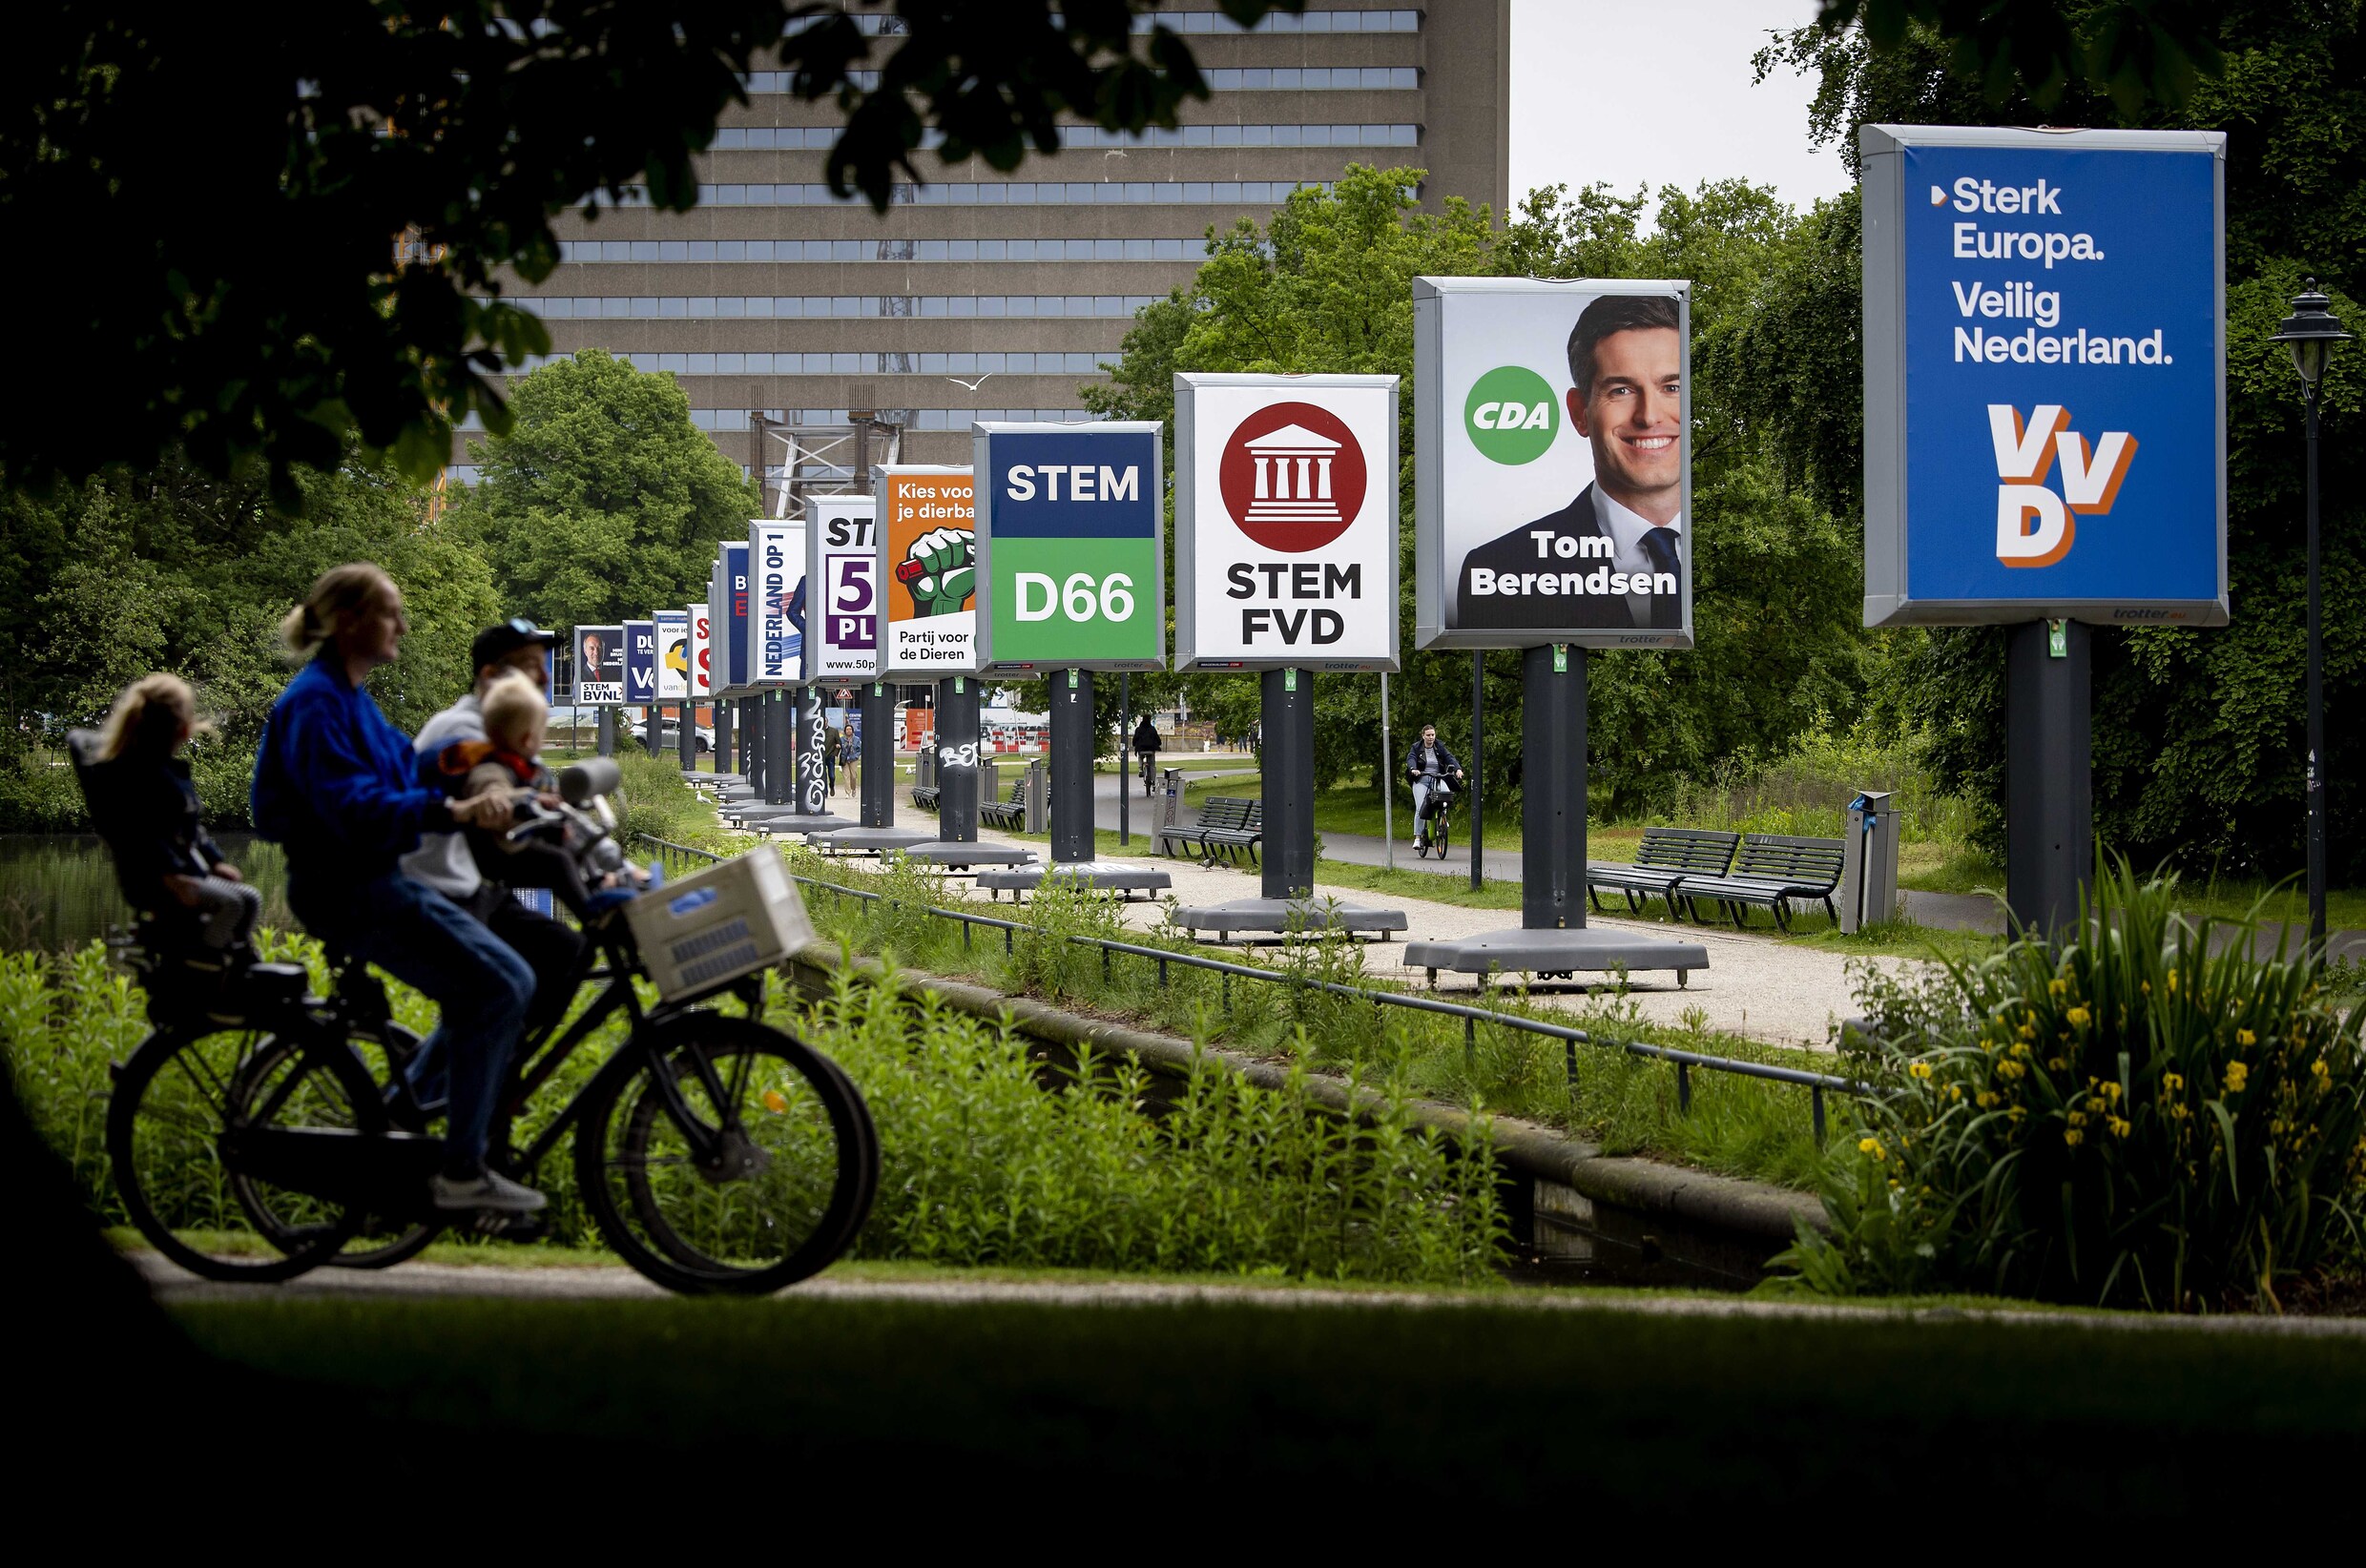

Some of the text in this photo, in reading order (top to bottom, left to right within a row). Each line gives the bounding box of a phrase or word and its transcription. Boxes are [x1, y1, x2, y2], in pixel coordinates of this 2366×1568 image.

[1953, 176, 2061, 215] Sterk
[1953, 222, 2105, 269] Europa.
[1952, 281, 2060, 327] Veilig
[1954, 327, 2172, 365] Nederland.
[1473, 402, 1549, 430] CDA
[898, 484, 973, 499] Kies voo
[1007, 464, 1139, 501] STEM
[1987, 404, 2139, 567] VVD
[897, 504, 975, 522] je dierba
[825, 517, 876, 547] ST
[1531, 530, 1613, 558] Tom
[766, 545, 783, 568] OP
[736, 576, 748, 589] B
[837, 562, 873, 612] 5
[1226, 563, 1361, 600] STEM
[1470, 567, 1676, 596] Berendsen
[1015, 572, 1135, 622] D66
[766, 573, 782, 675] NEDERLAND
[839, 618, 873, 641] PL
[900, 631, 968, 647] Partij voor
[1242, 609, 1344, 645] FVD
[900, 648, 965, 660] de Dieren
[584, 691, 621, 700] BVNL
